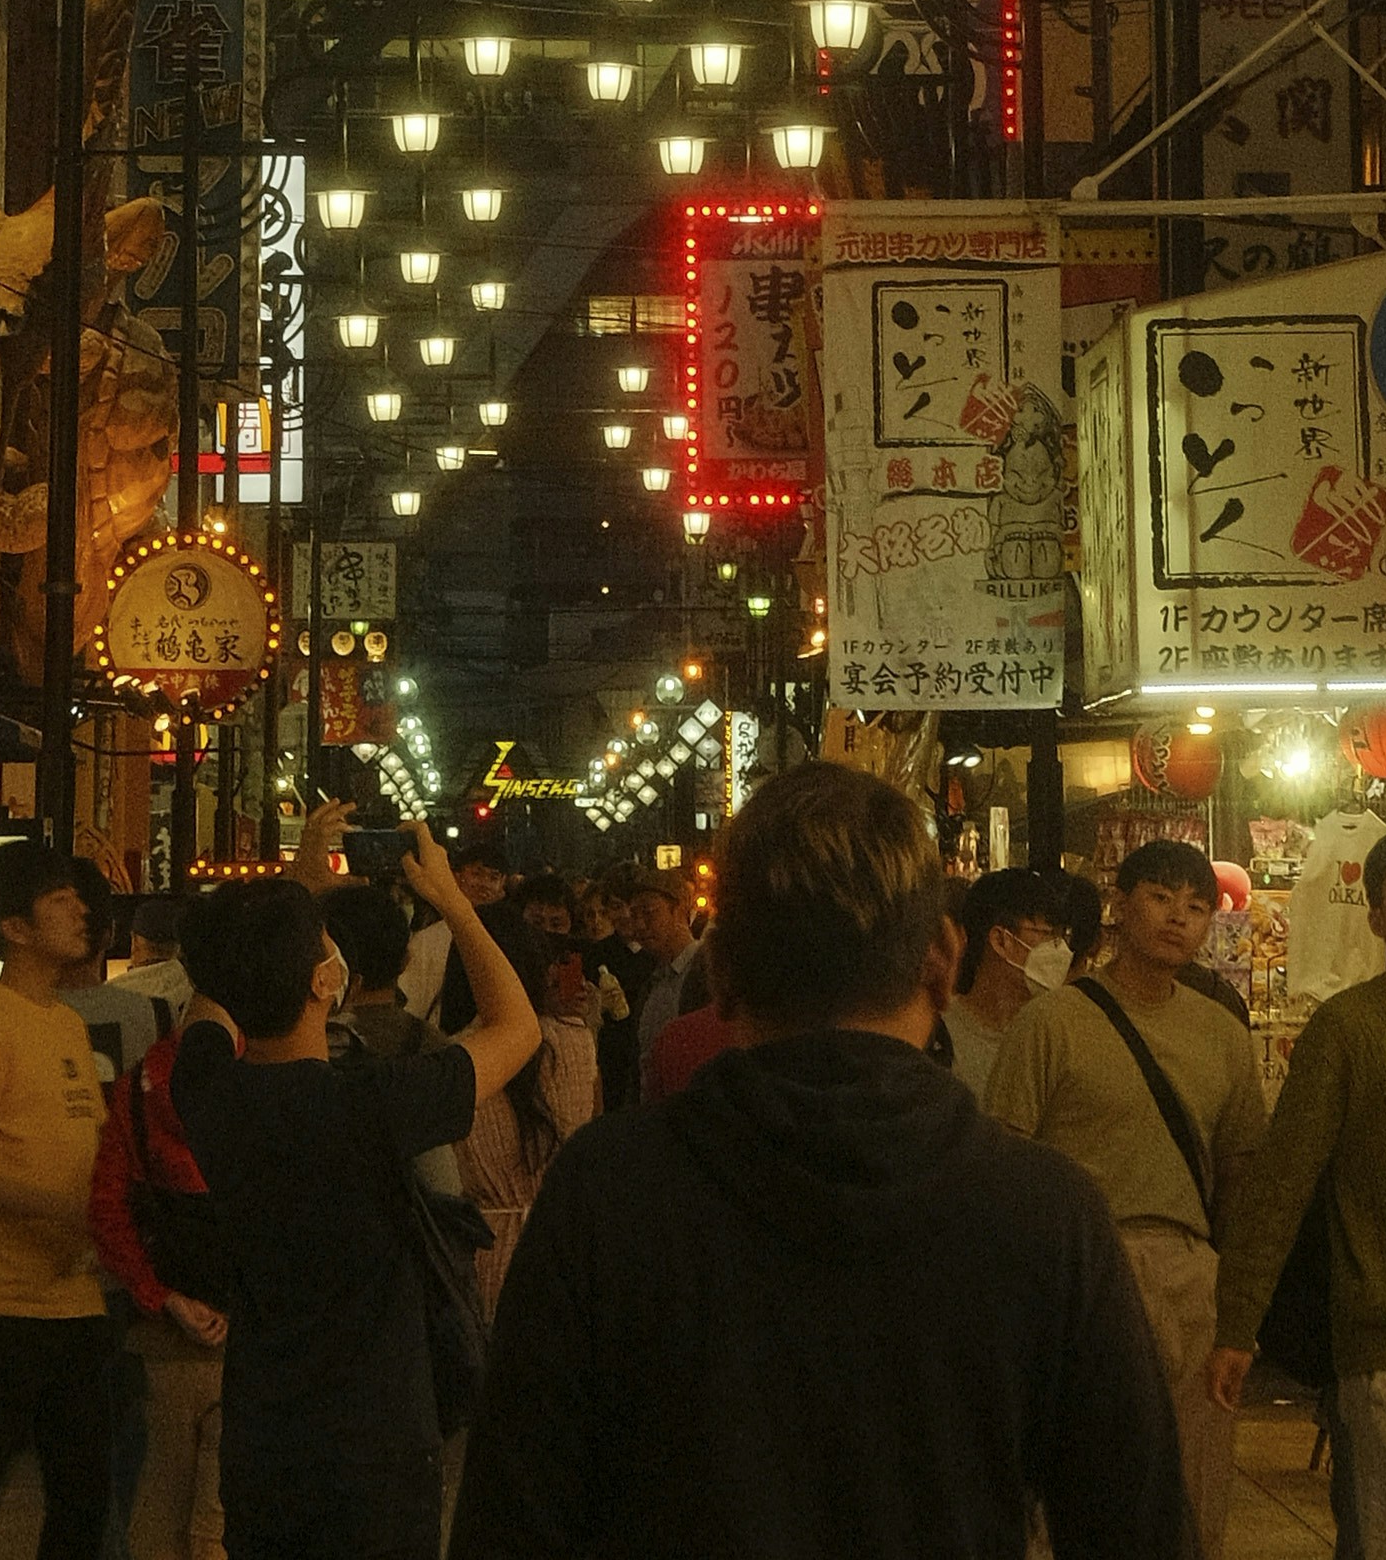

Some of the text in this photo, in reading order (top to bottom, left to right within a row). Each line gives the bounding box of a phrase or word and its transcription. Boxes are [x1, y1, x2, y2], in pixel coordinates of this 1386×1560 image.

[836, 231, 1047, 259] 元祖串カツ専門店
[1291, 352, 1342, 460] 新世界
[840, 661, 1055, 696] 宴会予約受付中
